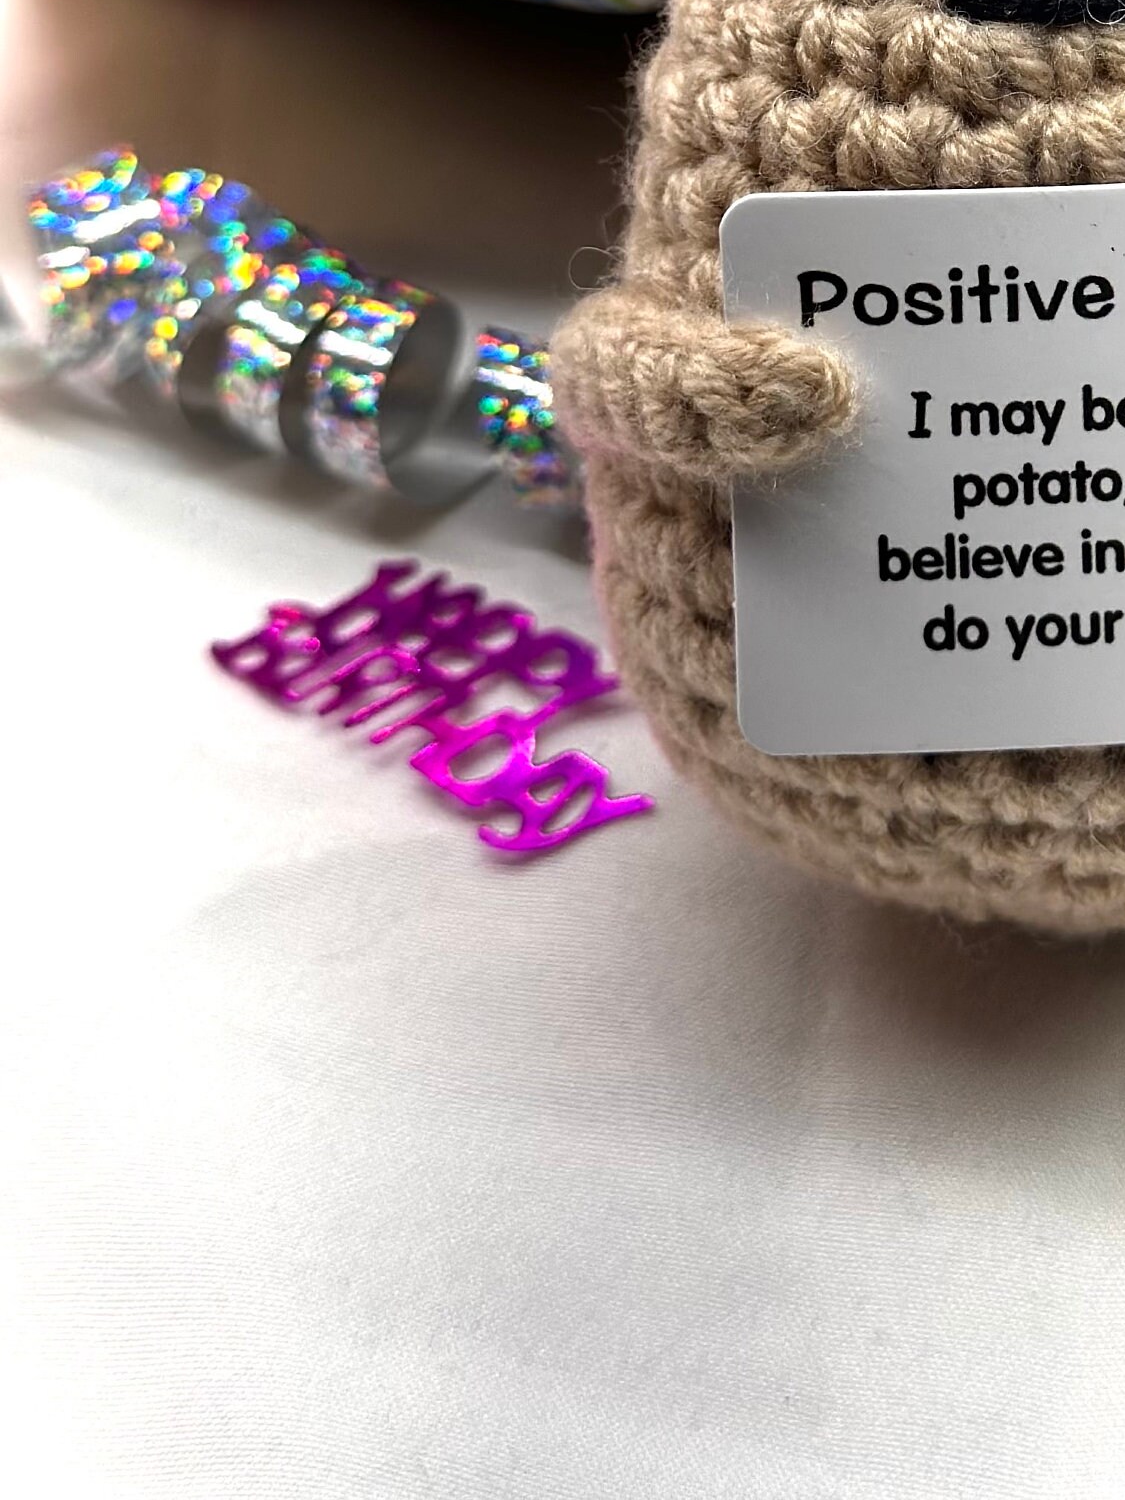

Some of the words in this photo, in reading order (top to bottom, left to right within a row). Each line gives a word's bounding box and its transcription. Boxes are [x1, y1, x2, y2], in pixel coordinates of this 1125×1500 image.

[797, 265, 1114, 327] Positive
[908, 391, 931, 438] I
[951, 399, 1065, 445] may
[878, 533, 1064, 582] believe
[1081, 529, 1125, 574] in
[923, 604, 989, 651] do
[1005, 610, 1123, 660] your
